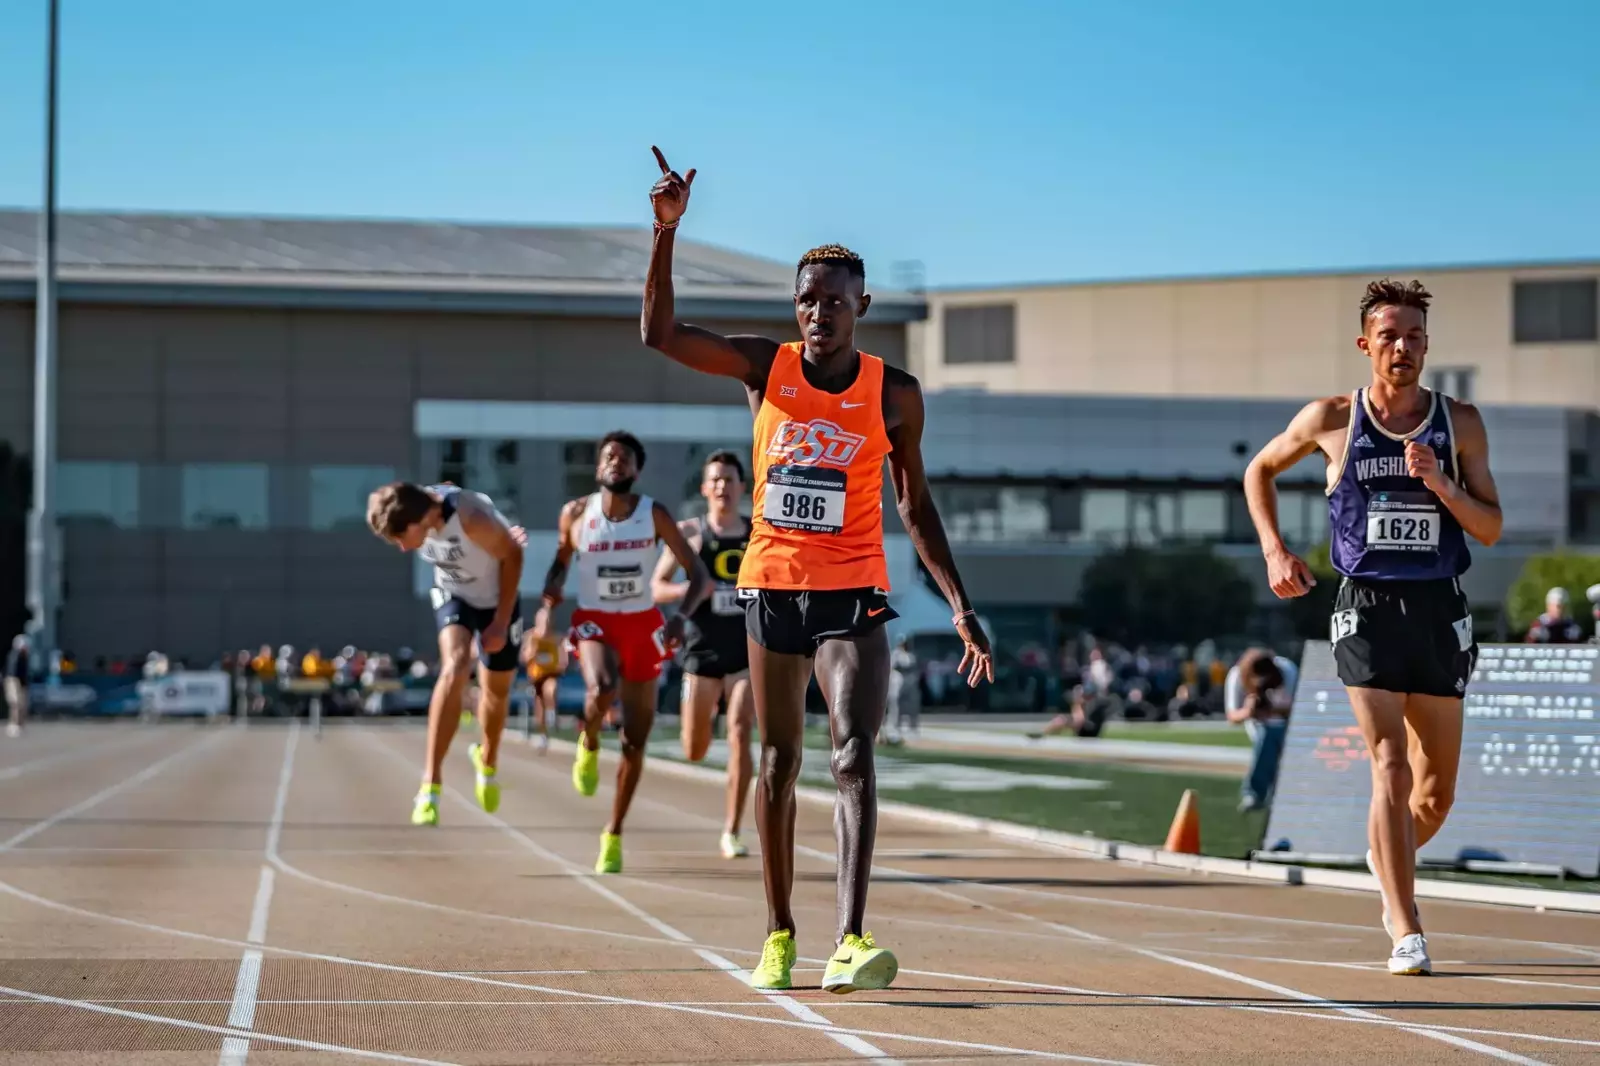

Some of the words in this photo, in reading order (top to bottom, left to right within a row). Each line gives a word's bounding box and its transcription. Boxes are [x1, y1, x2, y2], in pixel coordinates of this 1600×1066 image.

[768, 419, 867, 467] OSU
[781, 493, 827, 521] 986
[1377, 518, 1430, 541] 1628
